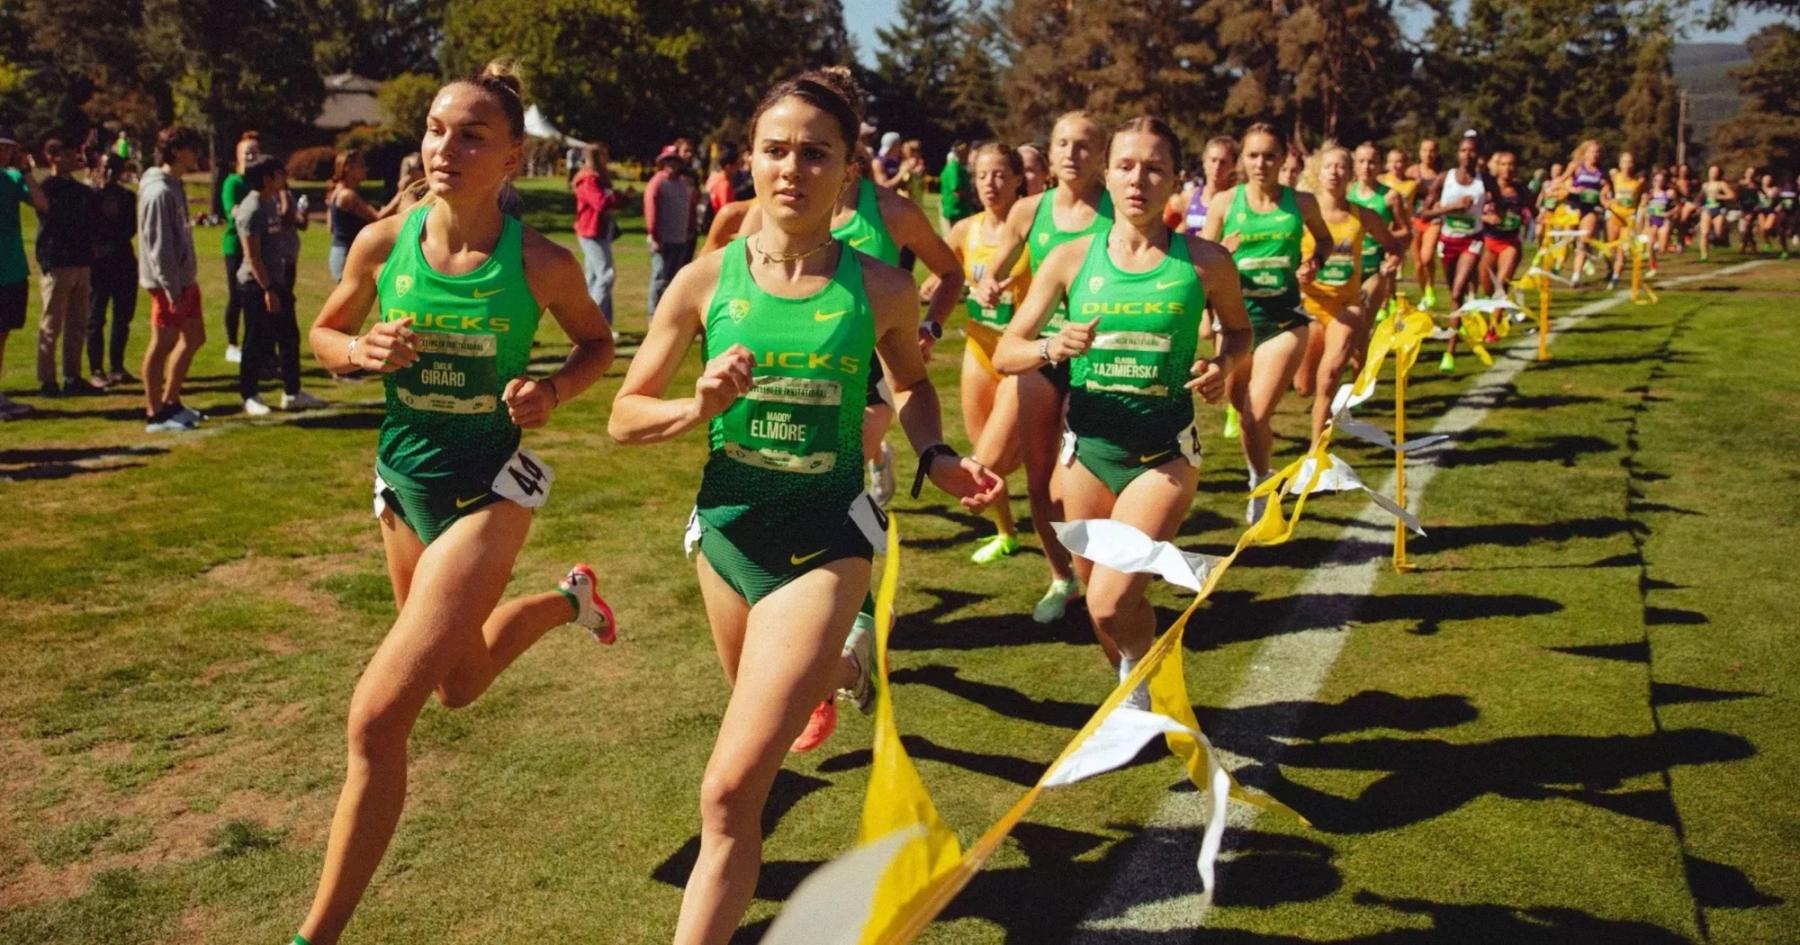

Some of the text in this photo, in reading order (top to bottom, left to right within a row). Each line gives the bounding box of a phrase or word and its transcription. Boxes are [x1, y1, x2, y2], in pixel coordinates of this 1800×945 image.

[1081, 302, 1184, 315] DUCKS
[757, 351, 859, 375] UCKS
[421, 369, 466, 387] GIRARD
[766, 411, 792, 422] MADDY
[750, 420, 807, 442] ELMORE
